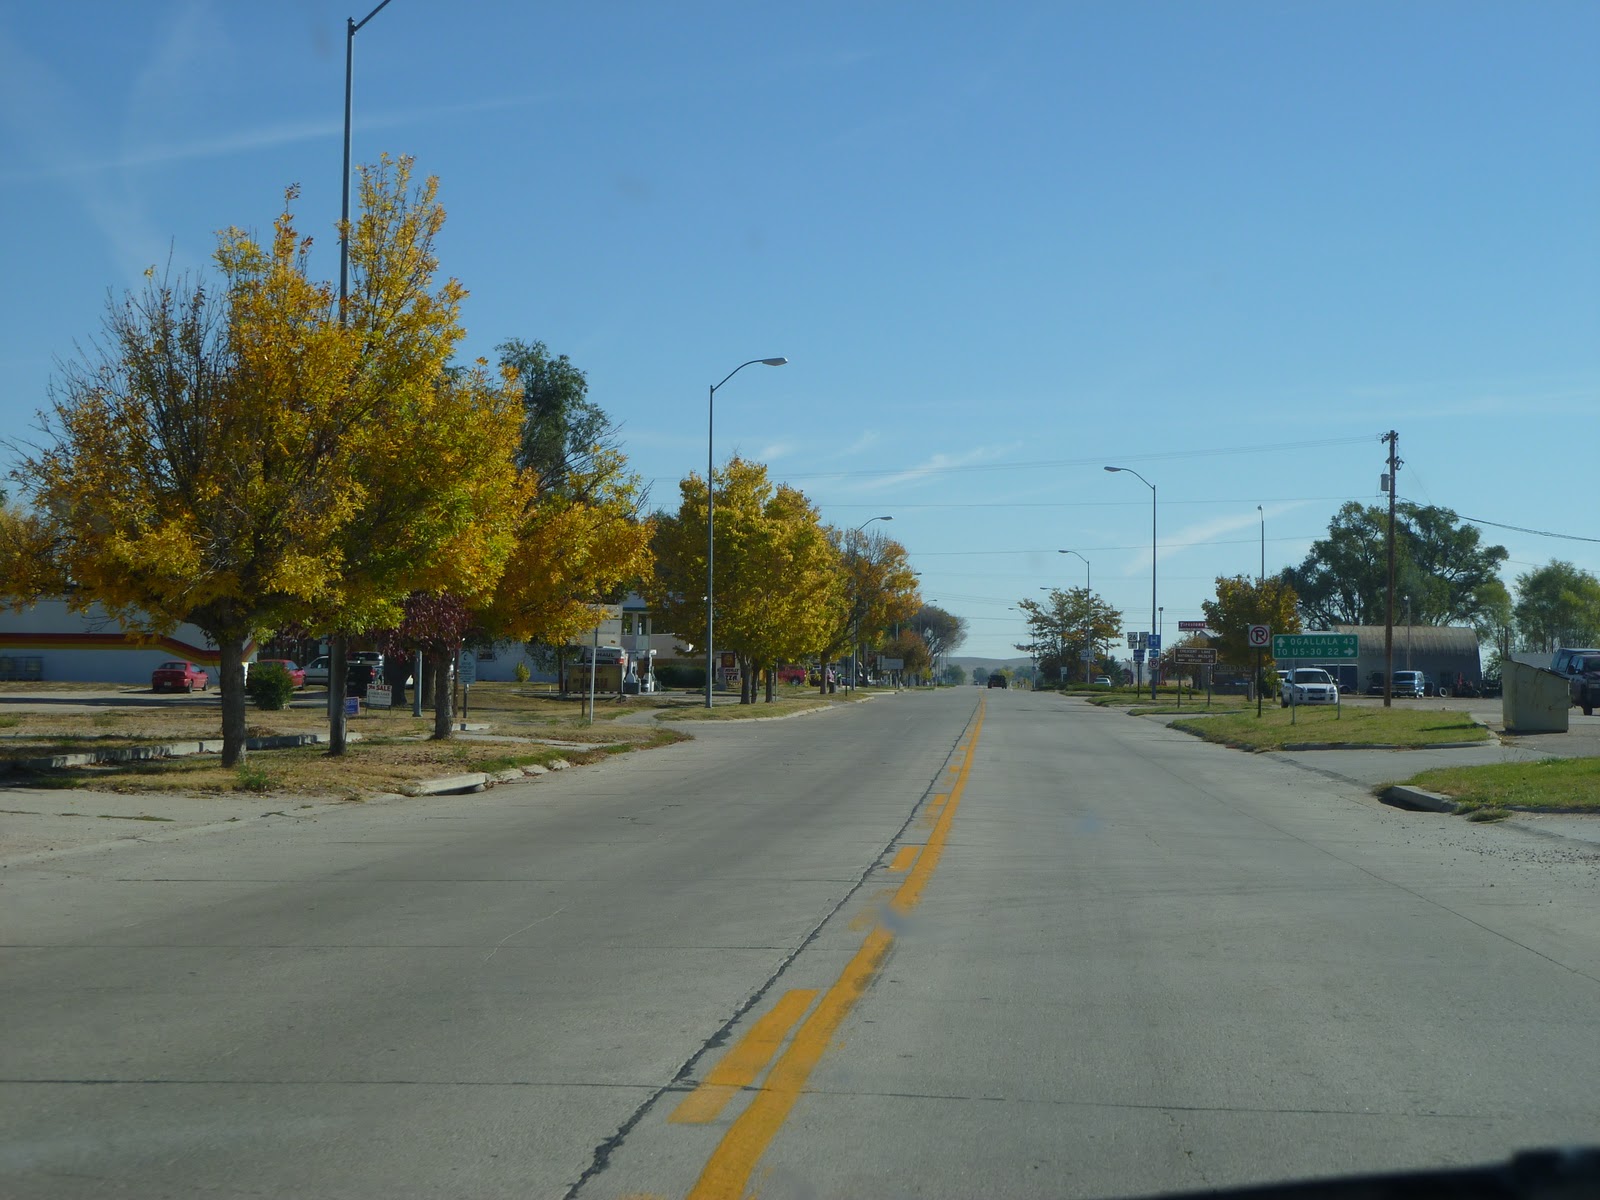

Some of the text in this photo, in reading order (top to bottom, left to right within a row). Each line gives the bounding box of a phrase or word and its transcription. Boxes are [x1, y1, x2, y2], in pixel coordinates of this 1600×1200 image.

[1150, 636, 1158, 645] H
[1290, 637, 1354, 645] OGALLALA 43
[1277, 648, 1339, 656] TO US-30 22
